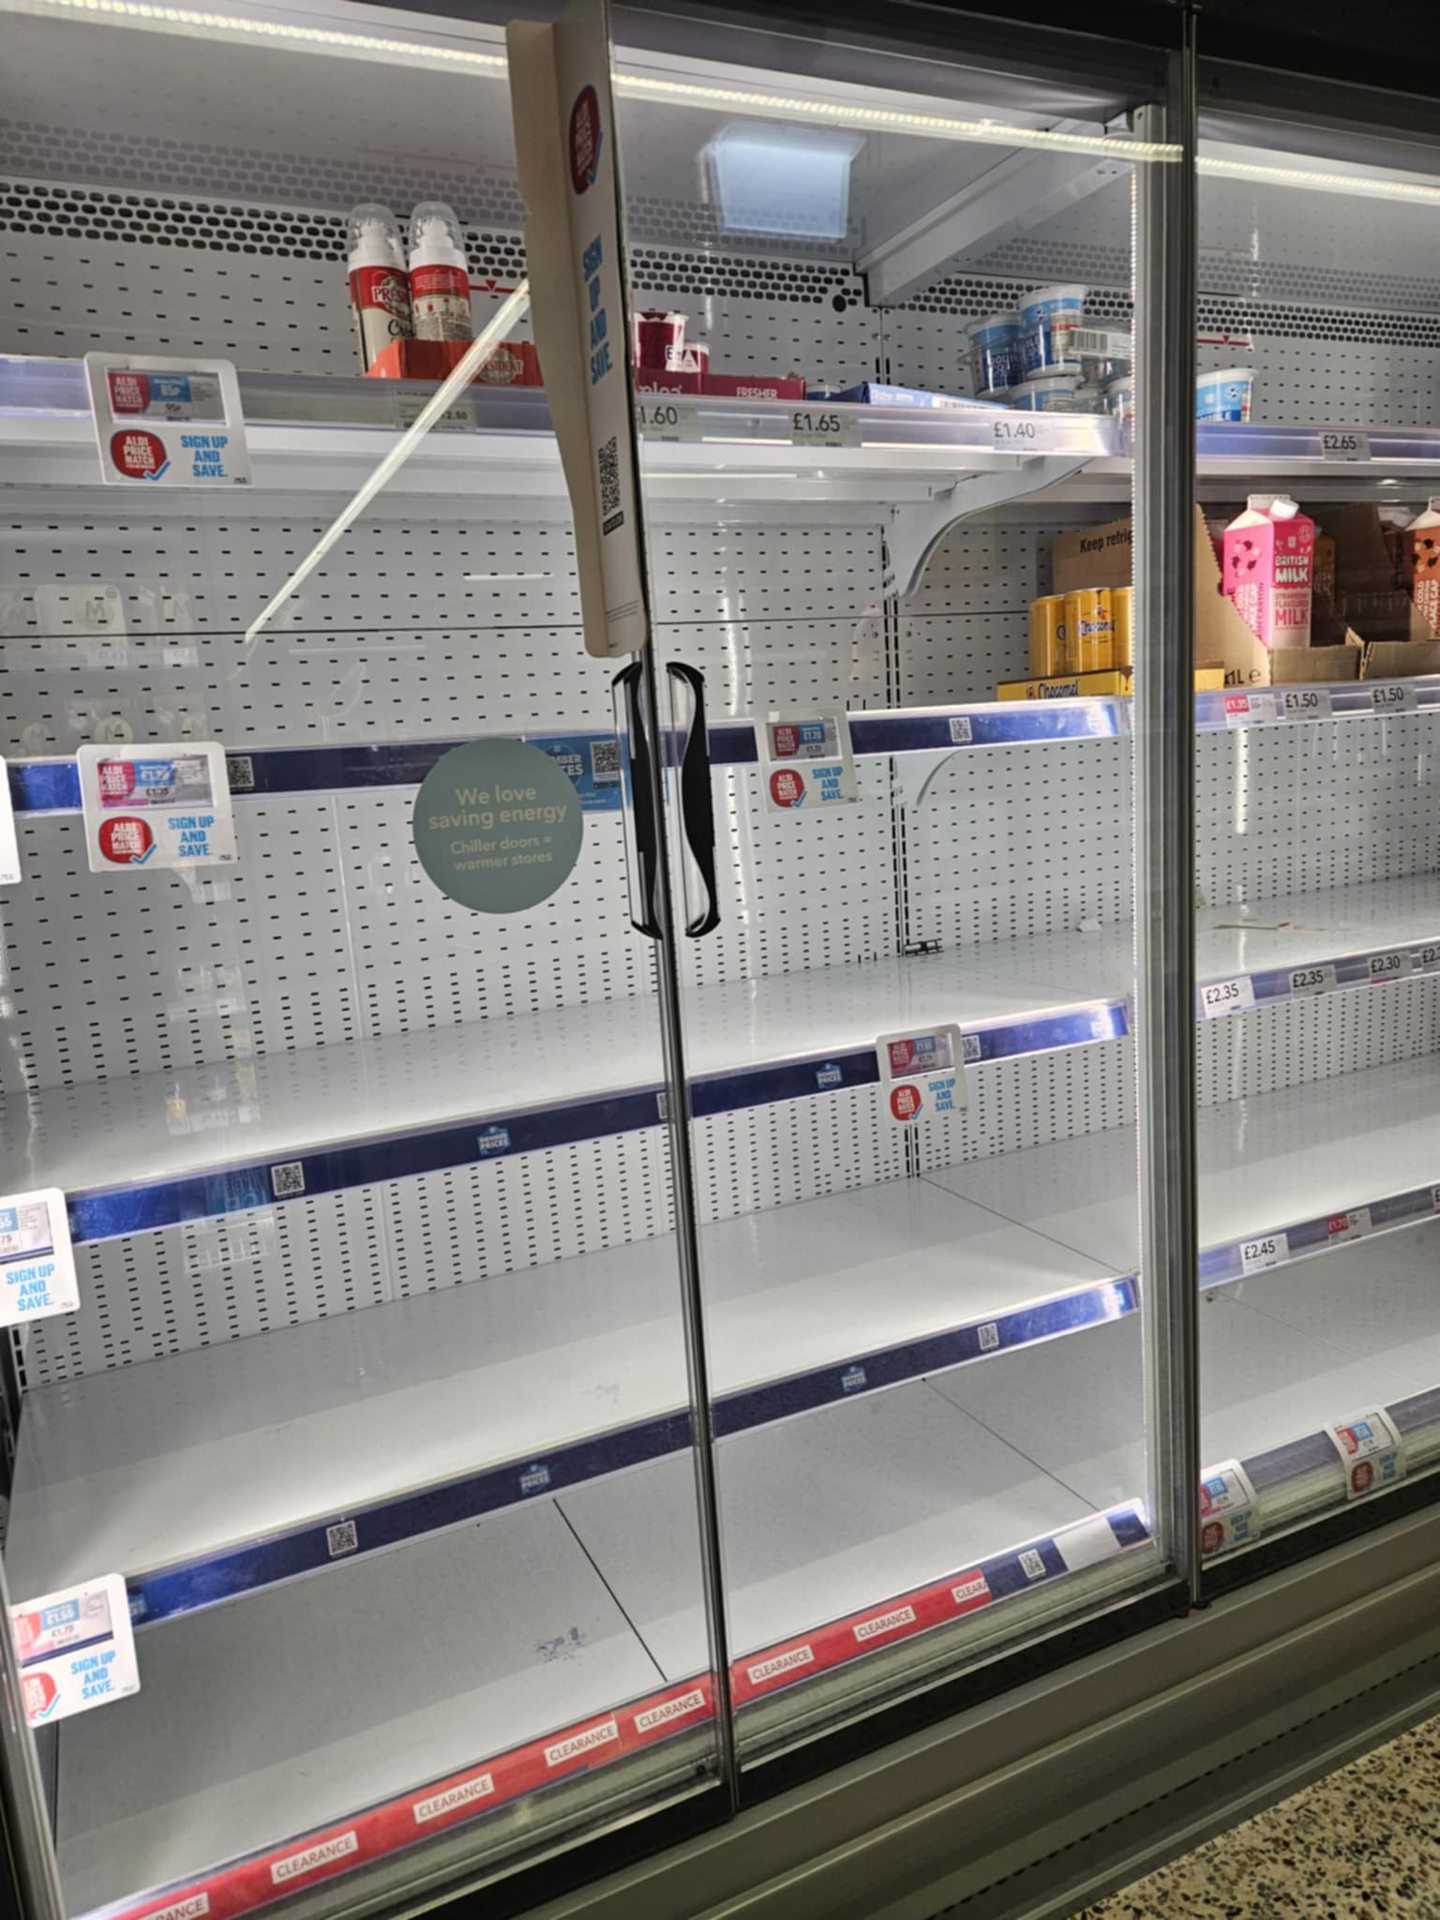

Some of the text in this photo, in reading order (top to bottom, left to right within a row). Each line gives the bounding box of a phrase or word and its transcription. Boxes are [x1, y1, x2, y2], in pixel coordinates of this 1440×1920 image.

[736, 387, 778, 400] FRESHER
[639, 405, 678, 425] 1.60
[793, 412, 840, 432] £1.65
[994, 422, 1036, 439] £1.40
[180, 435, 228, 449] SIGN UP
[1322, 434, 1357, 451] £2.65
[194, 450, 220, 463] AND
[1080, 537, 1104, 553] Keep
[1275, 555, 1309, 565] BRITISH
[1275, 567, 1309, 583] MILK
[1275, 608, 1309, 626] MILK
[1285, 692, 1318, 709] £1.50
[1374, 686, 1404, 704] £1.50
[812, 766, 844, 780] SIGN UP
[821, 779, 839, 790] AND
[455, 784, 537, 806] We love
[168, 815, 214, 830] SIGN UP
[428, 804, 567, 830] saving energy
[180, 831, 206, 843] AND
[450, 838, 496, 855] Chiller
[500, 836, 540, 851] doors
[454, 851, 553, 871] warmer stores
[1371, 955, 1401, 973] £2.30
[1292, 970, 1324, 988] £2.35
[1206, 982, 1239, 1005] £2.35
[1244, 1239, 1276, 1261] £2.45
[6, 1263, 55, 1285] SIGN UP
[20, 1280, 46, 1297] AND
[857, 1609, 912, 1638] CLEARANCE
[70, 1650, 116, 1675] SIGN UP
[752, 1649, 811, 1681] CLEARANCE
[84, 1668, 108, 1685] AND
[639, 1693, 702, 1729] CLEARANCE
[549, 1725, 615, 1762] CLEARANCE
[418, 1778, 491, 1818] CLEARANCE
[276, 1837, 354, 1879] CLEARANCE
